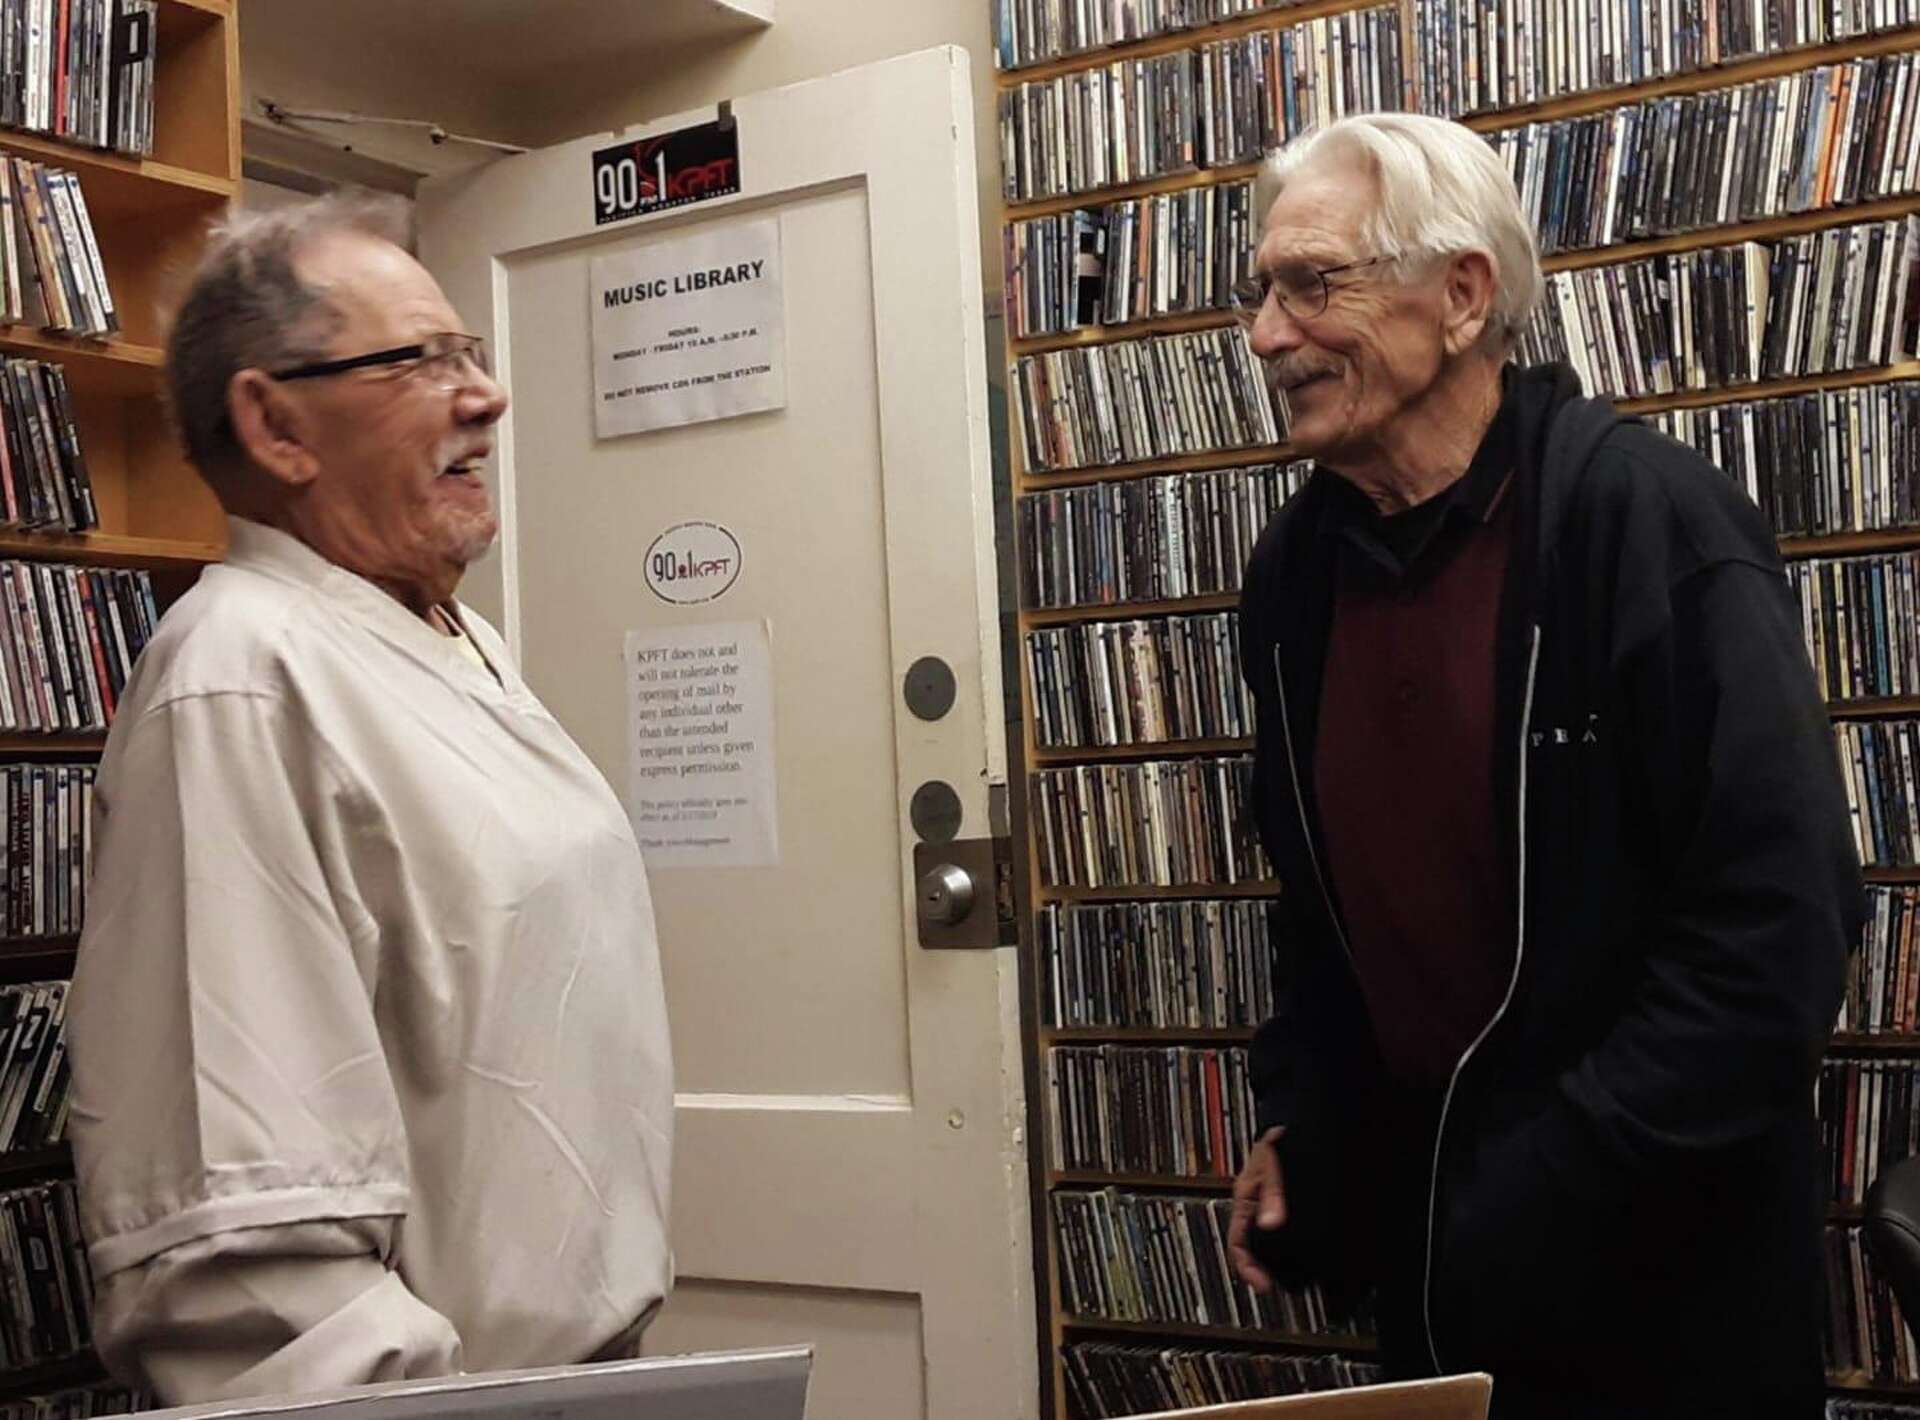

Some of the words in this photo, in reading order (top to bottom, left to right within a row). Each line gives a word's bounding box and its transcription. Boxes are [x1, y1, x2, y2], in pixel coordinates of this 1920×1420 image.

[604, 280, 667, 308] MUSIC
[674, 260, 764, 294] LIBRARY
[654, 341, 684, 356] FRIDAY
[617, 388, 634, 399] NOT
[635, 382, 670, 396] REMOVE
[691, 374, 715, 386] FROM
[717, 370, 733, 381] THE
[734, 364, 771, 379] STATION
[693, 558, 731, 578] KPFT
[637, 648, 669, 663] KPFT
[671, 648, 695, 660] does
[697, 647, 716, 658] not
[718, 642, 738, 656] and
[638, 670, 657, 682] will
[660, 668, 678, 680] not
[680, 663, 720, 680] tolerate
[722, 662, 739, 676] the
[682, 685, 694, 697] of
[696, 683, 720, 697] mail
[722, 682, 736, 698] by
[660, 703, 713, 719] individual
[715, 701, 743, 715] other
[639, 726, 662, 739] than
[687, 741, 720, 755] unless
[722, 741, 755, 756] given
